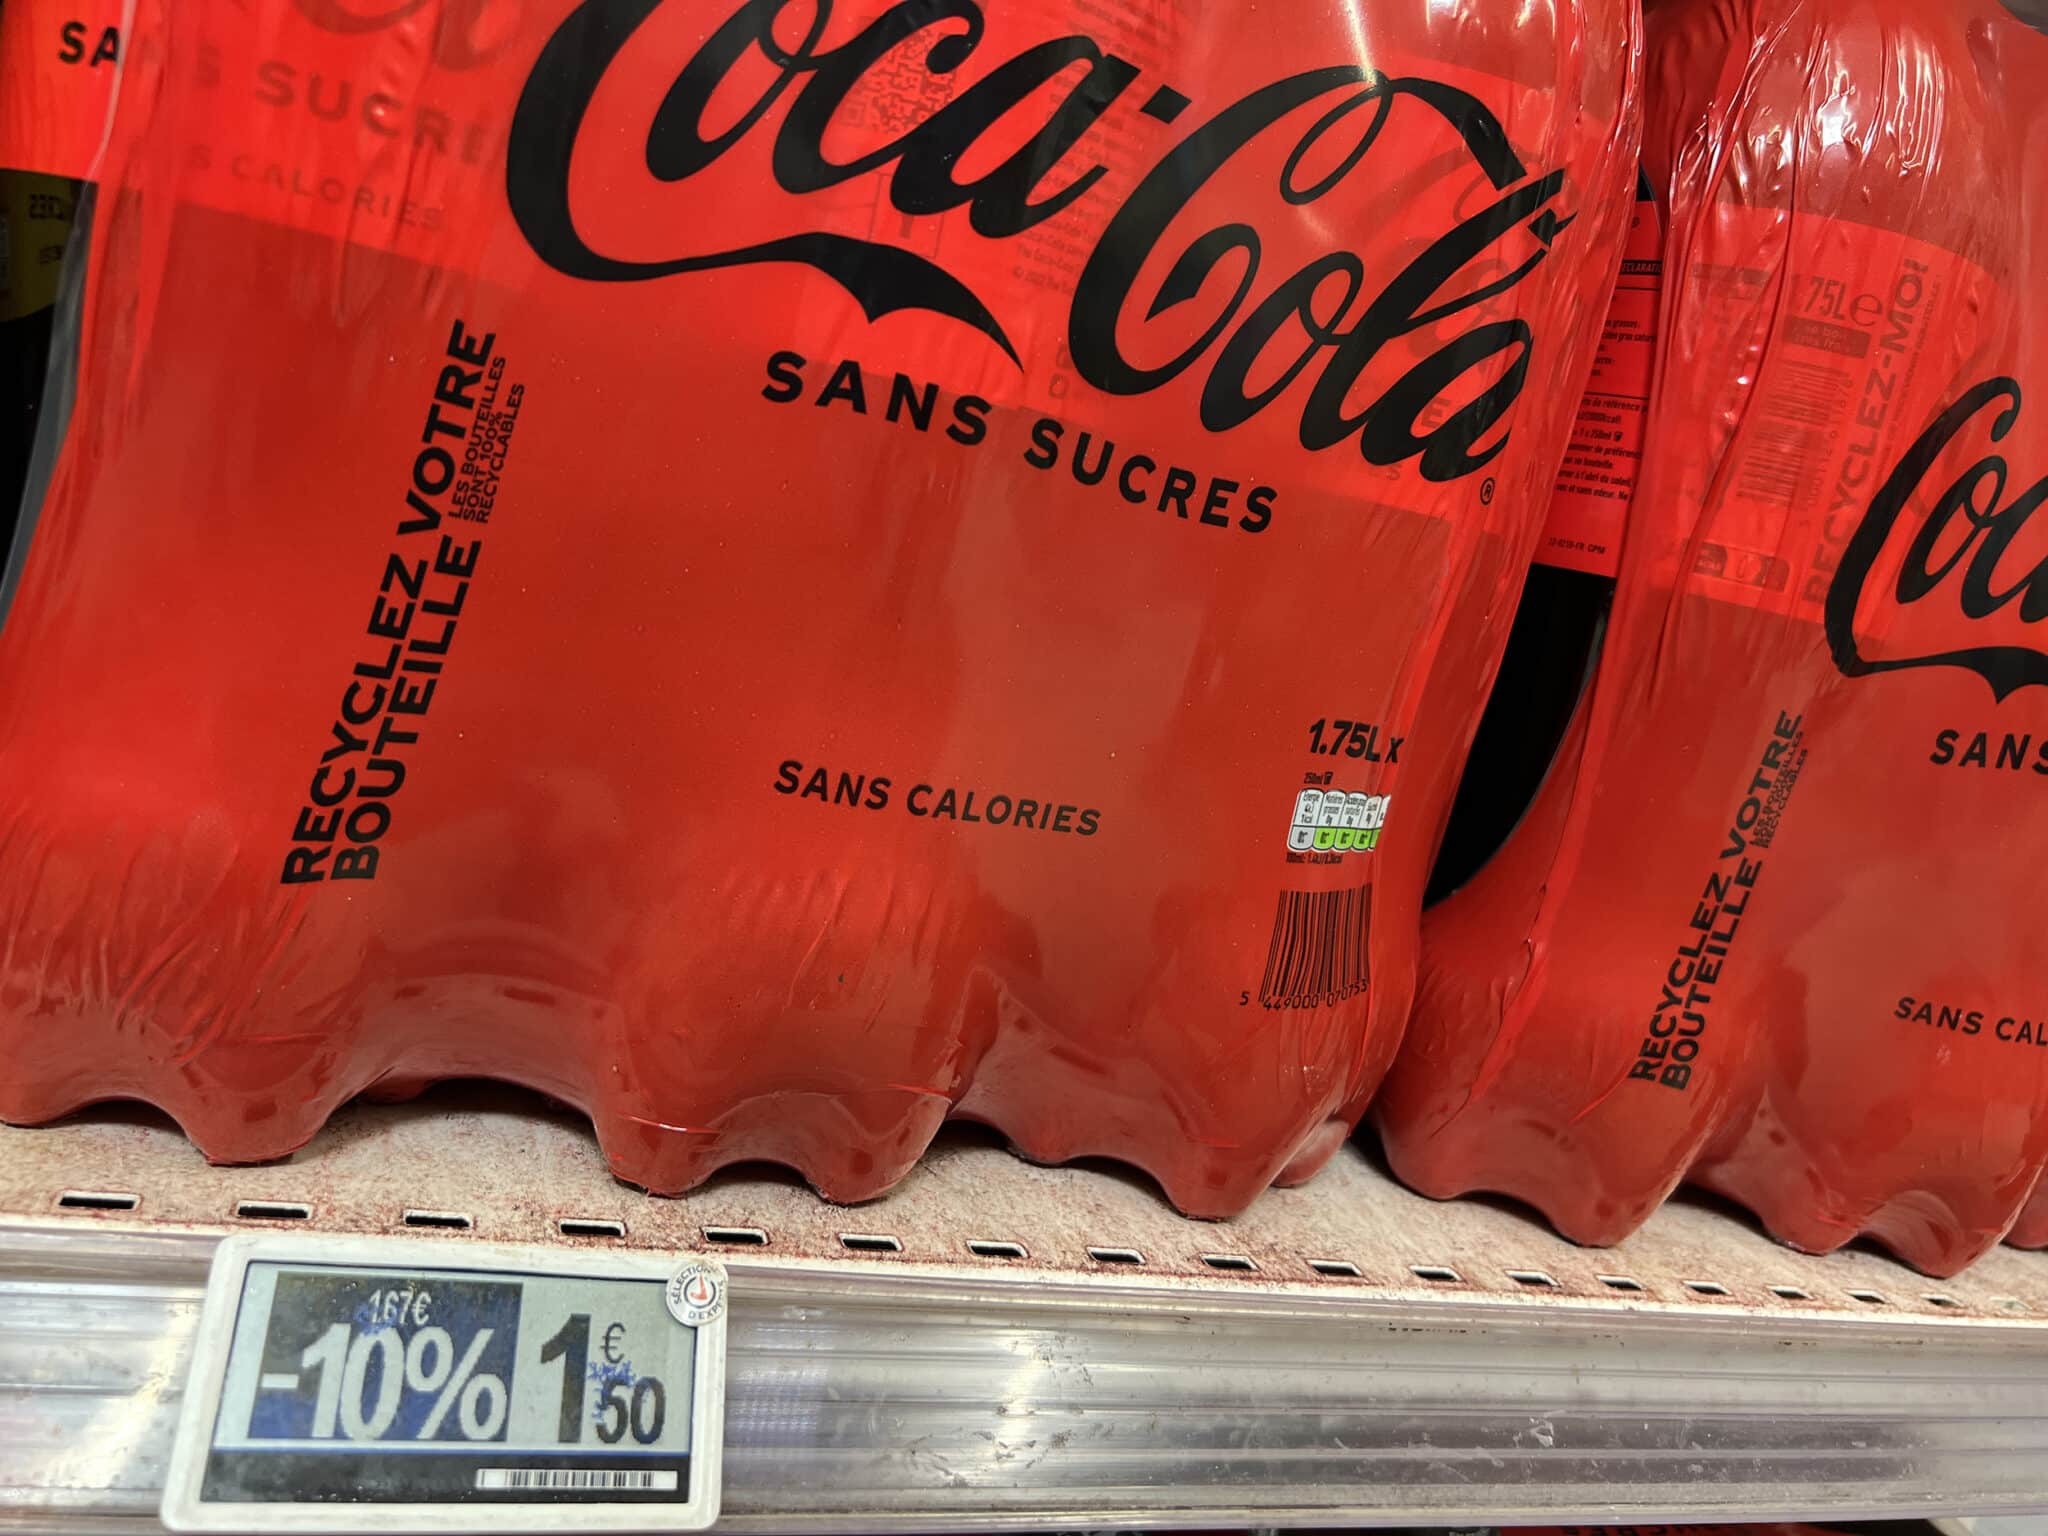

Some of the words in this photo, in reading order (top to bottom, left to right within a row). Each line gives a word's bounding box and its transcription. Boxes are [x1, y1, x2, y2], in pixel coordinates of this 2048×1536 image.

[448, 480, 470, 519] LES
[461, 356, 506, 475] BOUTEILLES
[463, 466, 486, 521] SONT
[480, 411, 504, 461] 100%
[475, 384, 525, 524] RECYCLABLES
[762, 351, 993, 446] SANS
[1024, 419, 1278, 533] SUCRES
[280, 553, 429, 884] RECYCLEZ
[397, 319, 496, 536] VOTRE
[330, 535, 482, 881] BOUTEILLE
[1308, 718, 1381, 763] 1.75L
[774, 760, 891, 810] SANS
[906, 784, 1102, 836] CALORIES
[1628, 872, 1732, 1081] RECYCLEZ
[1719, 709, 1802, 860] VOTRE
[1239, 991, 1250, 1006] 5
[1660, 858, 1762, 1090] BOUTEILLE
[1893, 997, 1983, 1035] SANS
[260, 1321, 508, 1441] -10%
[541, 1314, 592, 1443] 1
[596, 1376, 666, 1445] 50
